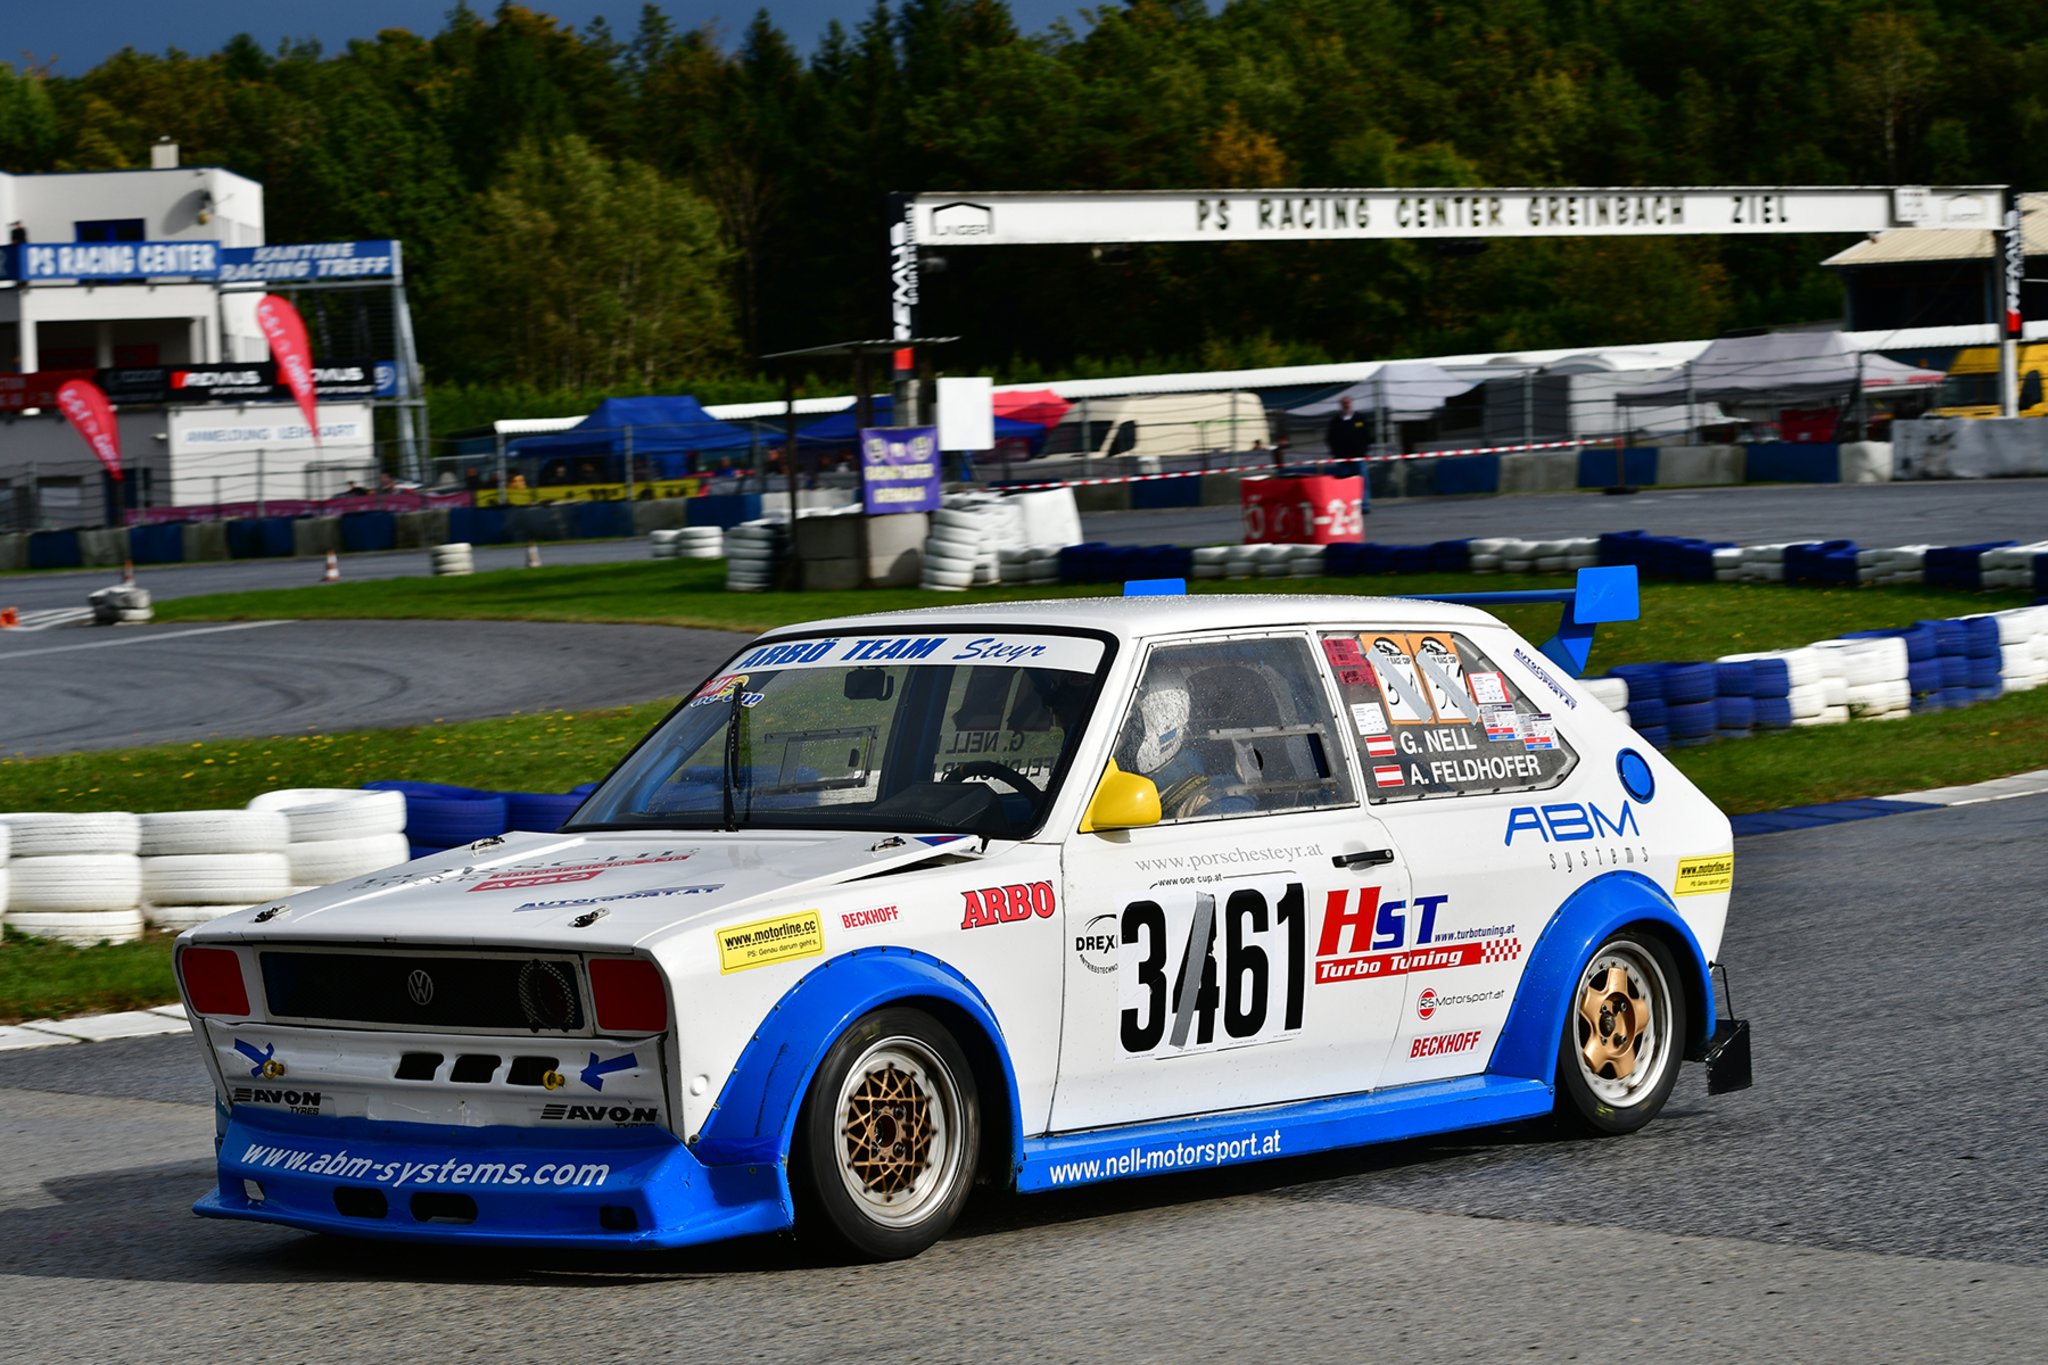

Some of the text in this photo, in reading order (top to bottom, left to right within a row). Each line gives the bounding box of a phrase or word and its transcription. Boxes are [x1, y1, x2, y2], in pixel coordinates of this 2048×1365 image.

[1196, 195, 1789, 230] PS RACING CENTER GREINBACH ZIEL
[28, 246, 55, 275] PS
[58, 245, 135, 275] RACING
[138, 243, 216, 273] CENTER
[252, 242, 355, 262] KANTINE
[218, 256, 390, 281] RACING TREFF
[733, 638, 1046, 671] ARBÖ TEAM Steyr
[1400, 727, 1477, 755] G. NELL
[1410, 754, 1542, 786] A. FELDHOFER
[1504, 800, 1640, 846] ABM
[1135, 842, 1324, 871] www.porschesteyr.at
[1549, 846, 1649, 873] systems
[841, 905, 899, 929] BECKHOFF
[724, 920, 816, 948] www.motorline.cc
[1434, 924, 1515, 942] www.turbotuning.at
[1320, 949, 1463, 978] Turbo Tuning
[1410, 1030, 1481, 1058] BECKHOFF
[253, 1089, 322, 1106] AVON
[289, 1106, 320, 1116] TYRES
[566, 1105, 658, 1122] AVON
[241, 1142, 610, 1187] www.abm-systems.com
[1050, 1129, 1281, 1184] www.nell-motorsport.at
